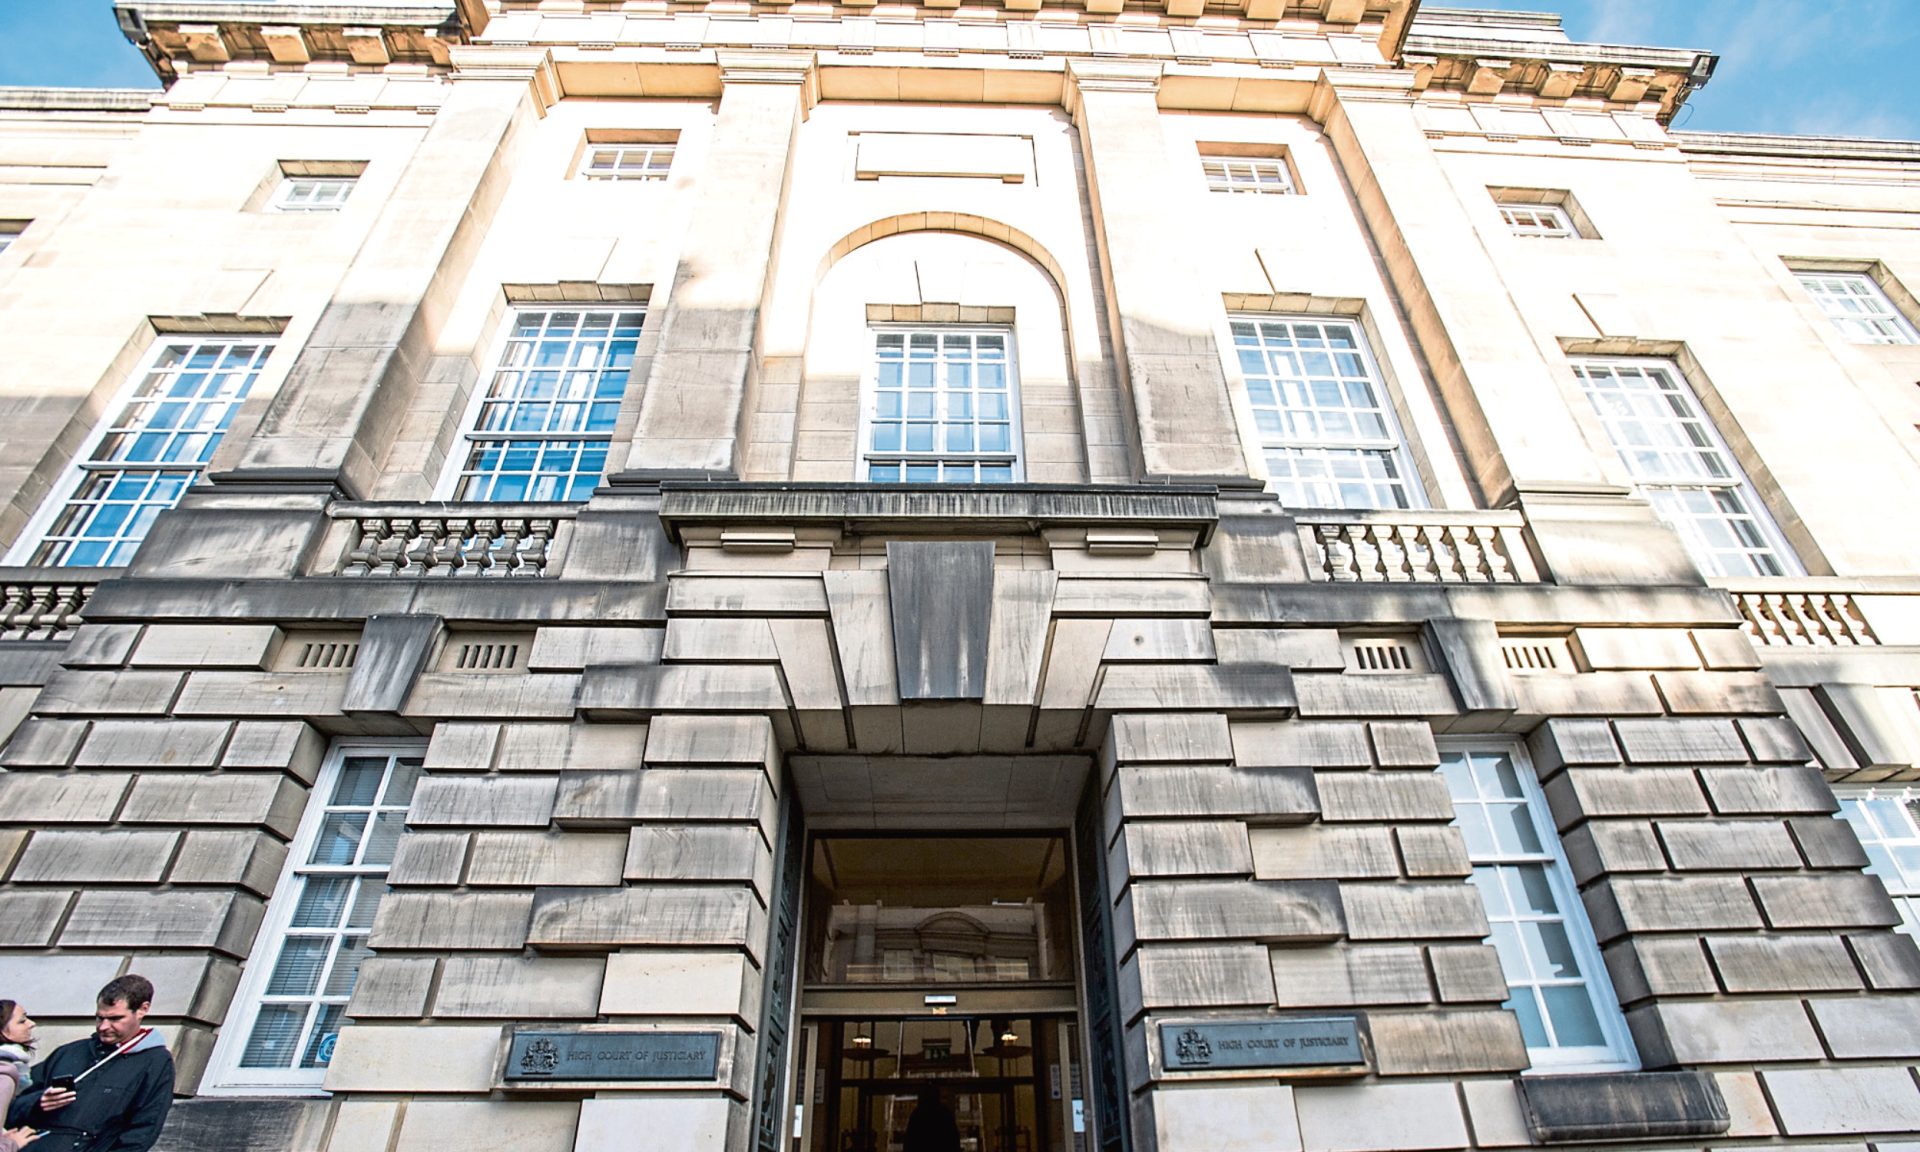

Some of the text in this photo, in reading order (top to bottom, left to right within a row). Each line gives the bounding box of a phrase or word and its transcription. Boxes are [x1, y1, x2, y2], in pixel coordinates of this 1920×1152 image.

[1218, 1036, 1349, 1050] HIGH COURT OF JUSTICIARY
[567, 1051, 706, 1062] HIGH COURT OF JUSTICIARY
